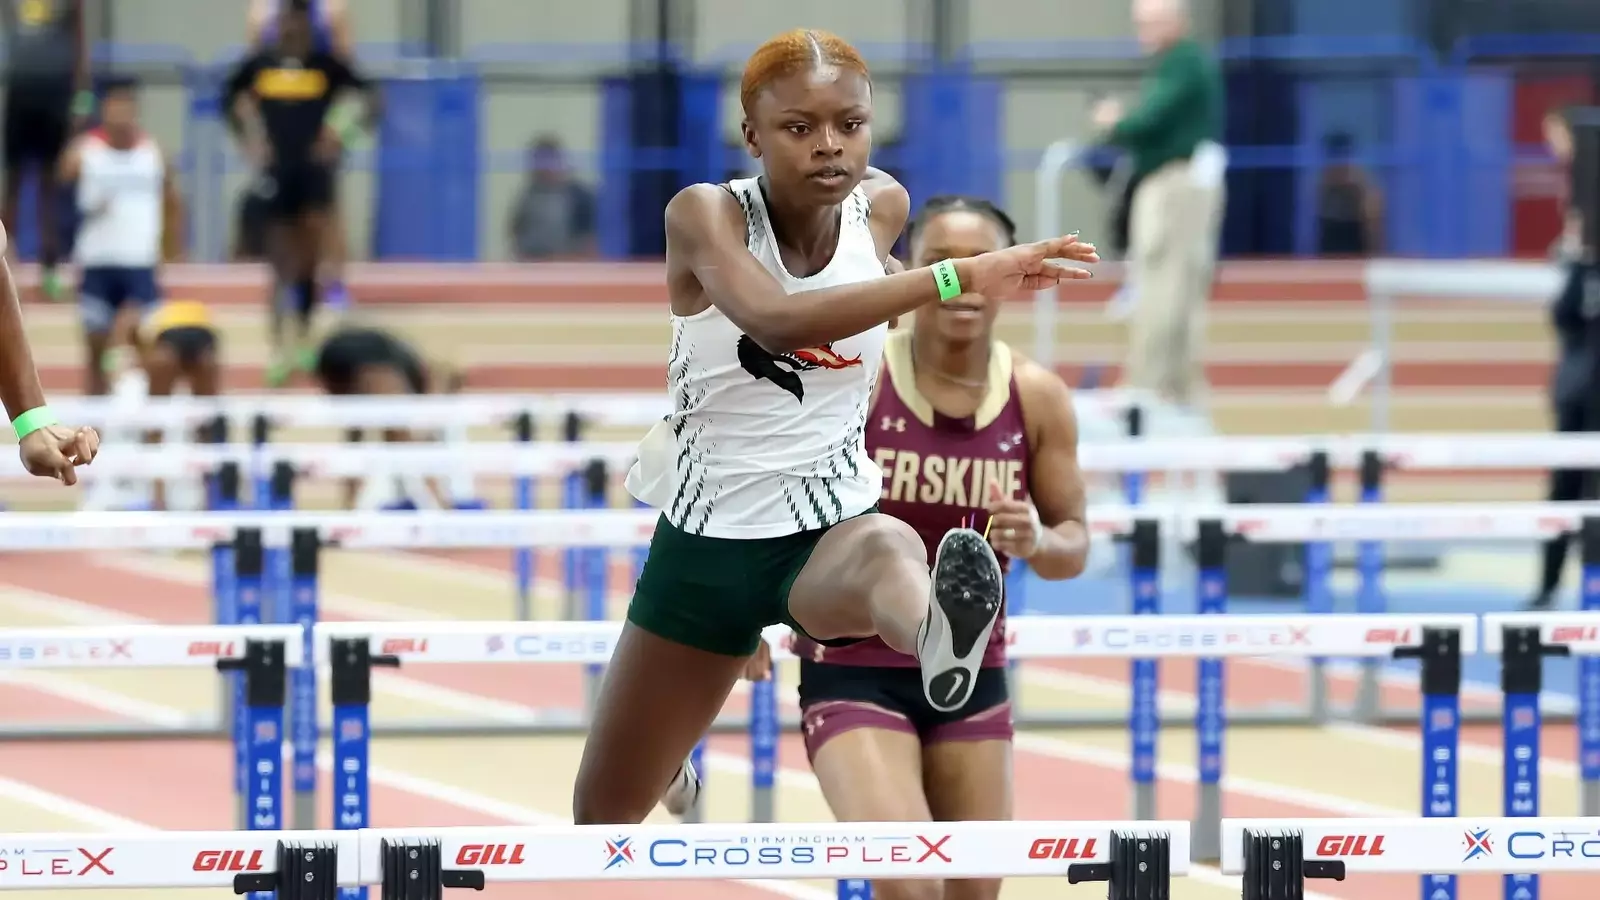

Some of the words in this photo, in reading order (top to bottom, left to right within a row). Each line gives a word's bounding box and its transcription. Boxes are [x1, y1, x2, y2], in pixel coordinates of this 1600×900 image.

[939, 263, 952, 288] TEAM
[874, 447, 1024, 510] ERSKINE
[649, 834, 952, 867] CROSSPLEX
[740, 835, 866, 844] BIRMINGHAM
[1028, 838, 1097, 860] GILL
[1316, 835, 1385, 857] GILL
[192, 850, 264, 872] GILL
[455, 844, 525, 866] GILL
